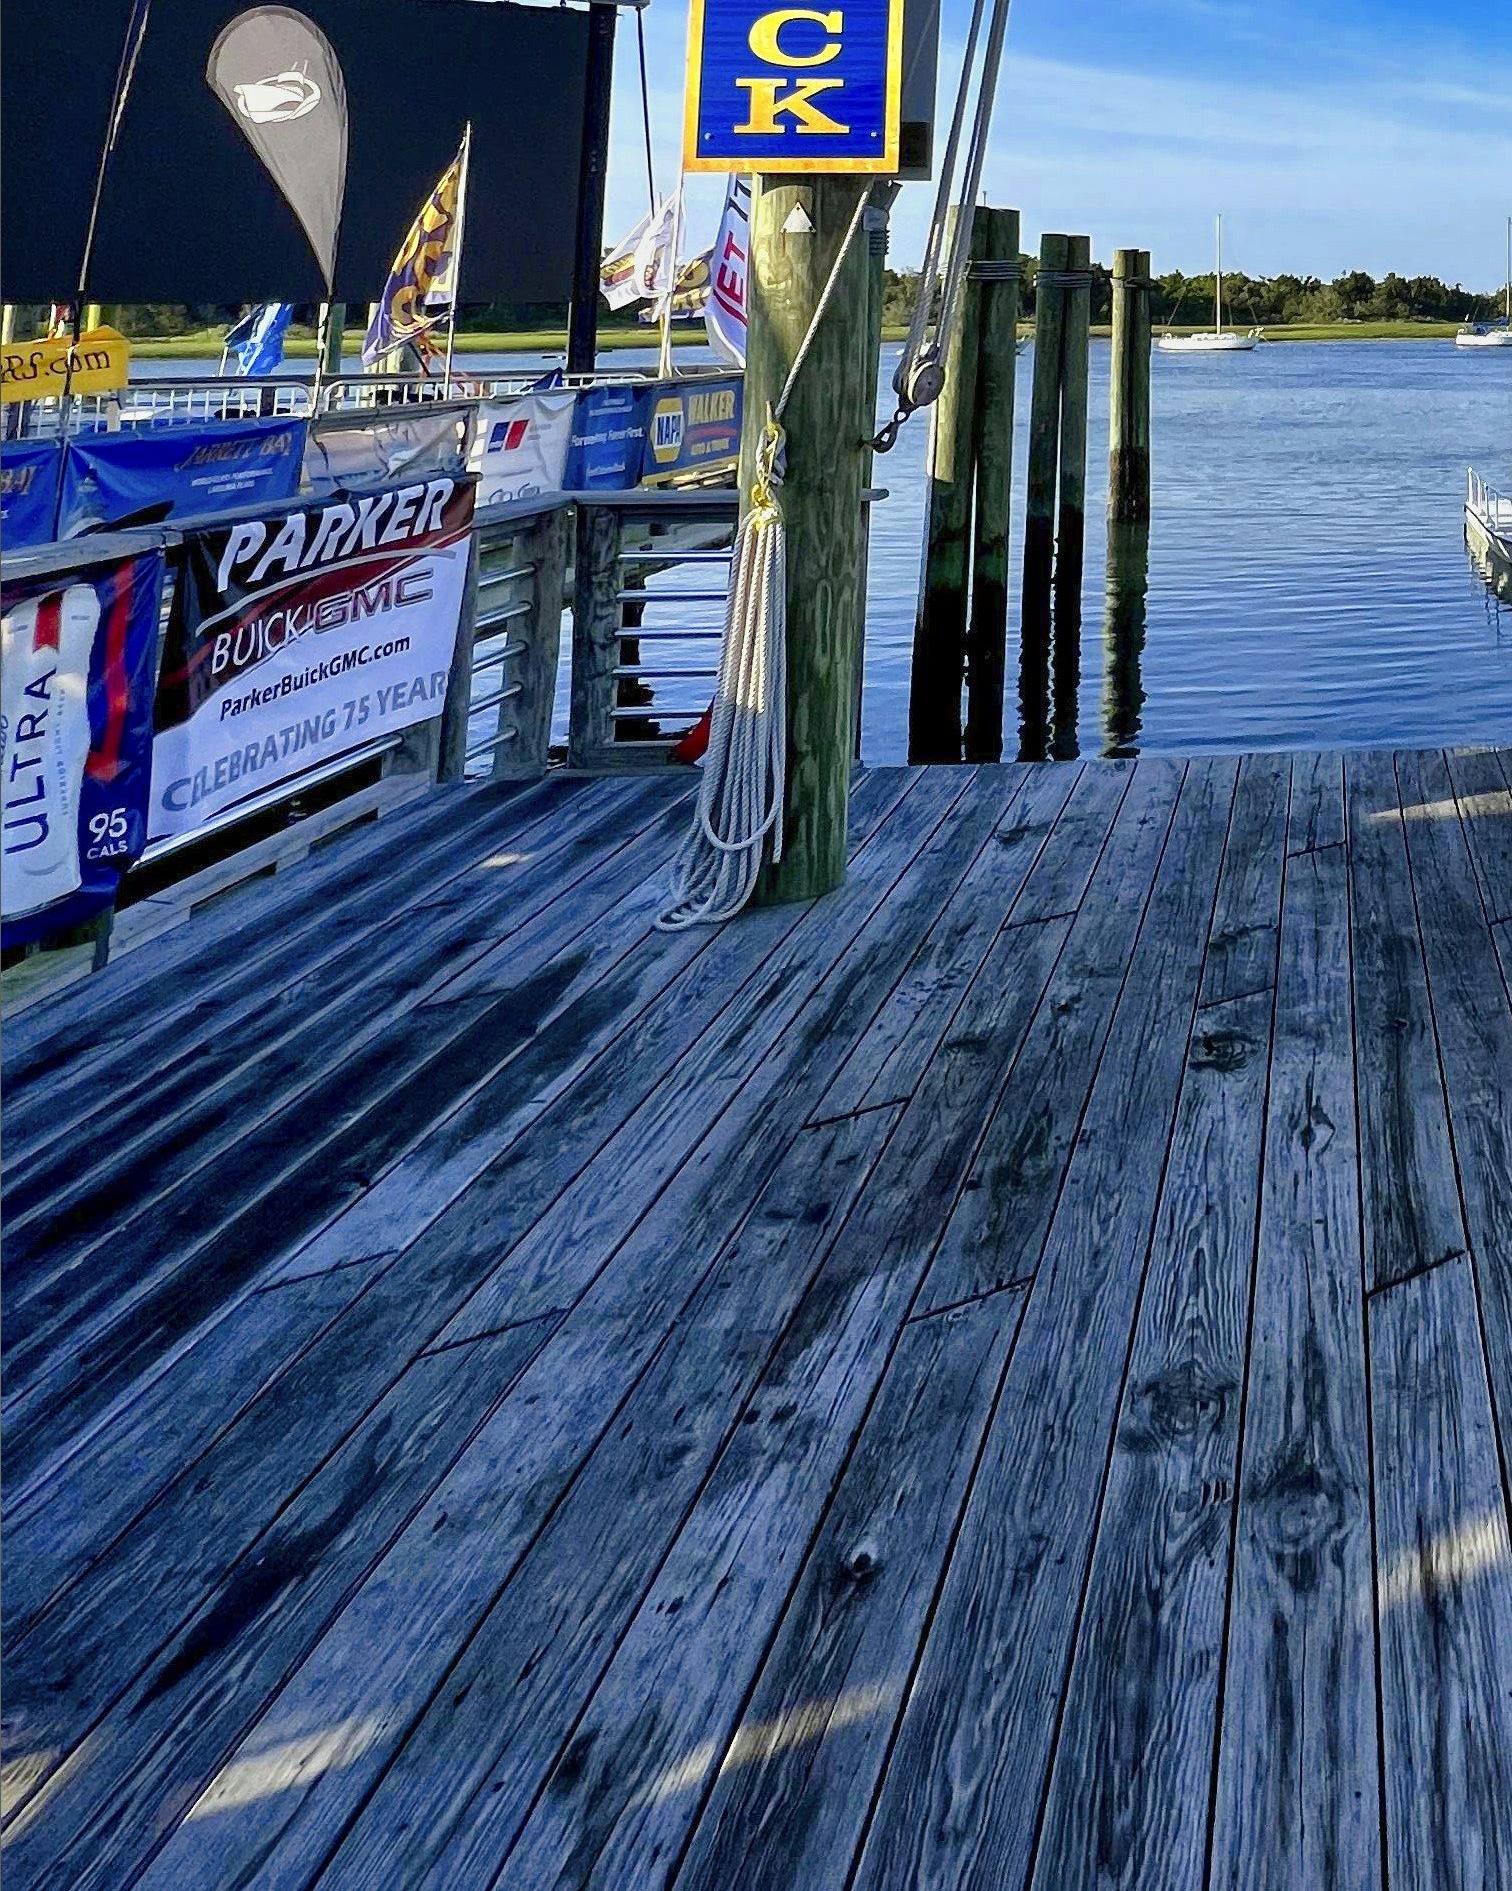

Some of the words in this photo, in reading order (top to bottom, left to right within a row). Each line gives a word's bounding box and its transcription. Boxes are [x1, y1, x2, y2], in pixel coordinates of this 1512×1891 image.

[217, 477, 455, 593] PARKER
[211, 604, 305, 675] BUICK
[312, 567, 434, 635] GMC
[219, 636, 411, 722] ParkerBuickGMC.com
[343, 693, 370, 731] 75
[4, 668, 56, 855] ULTRA
[87, 840, 128, 860] CALS
[88, 807, 128, 844] 95
